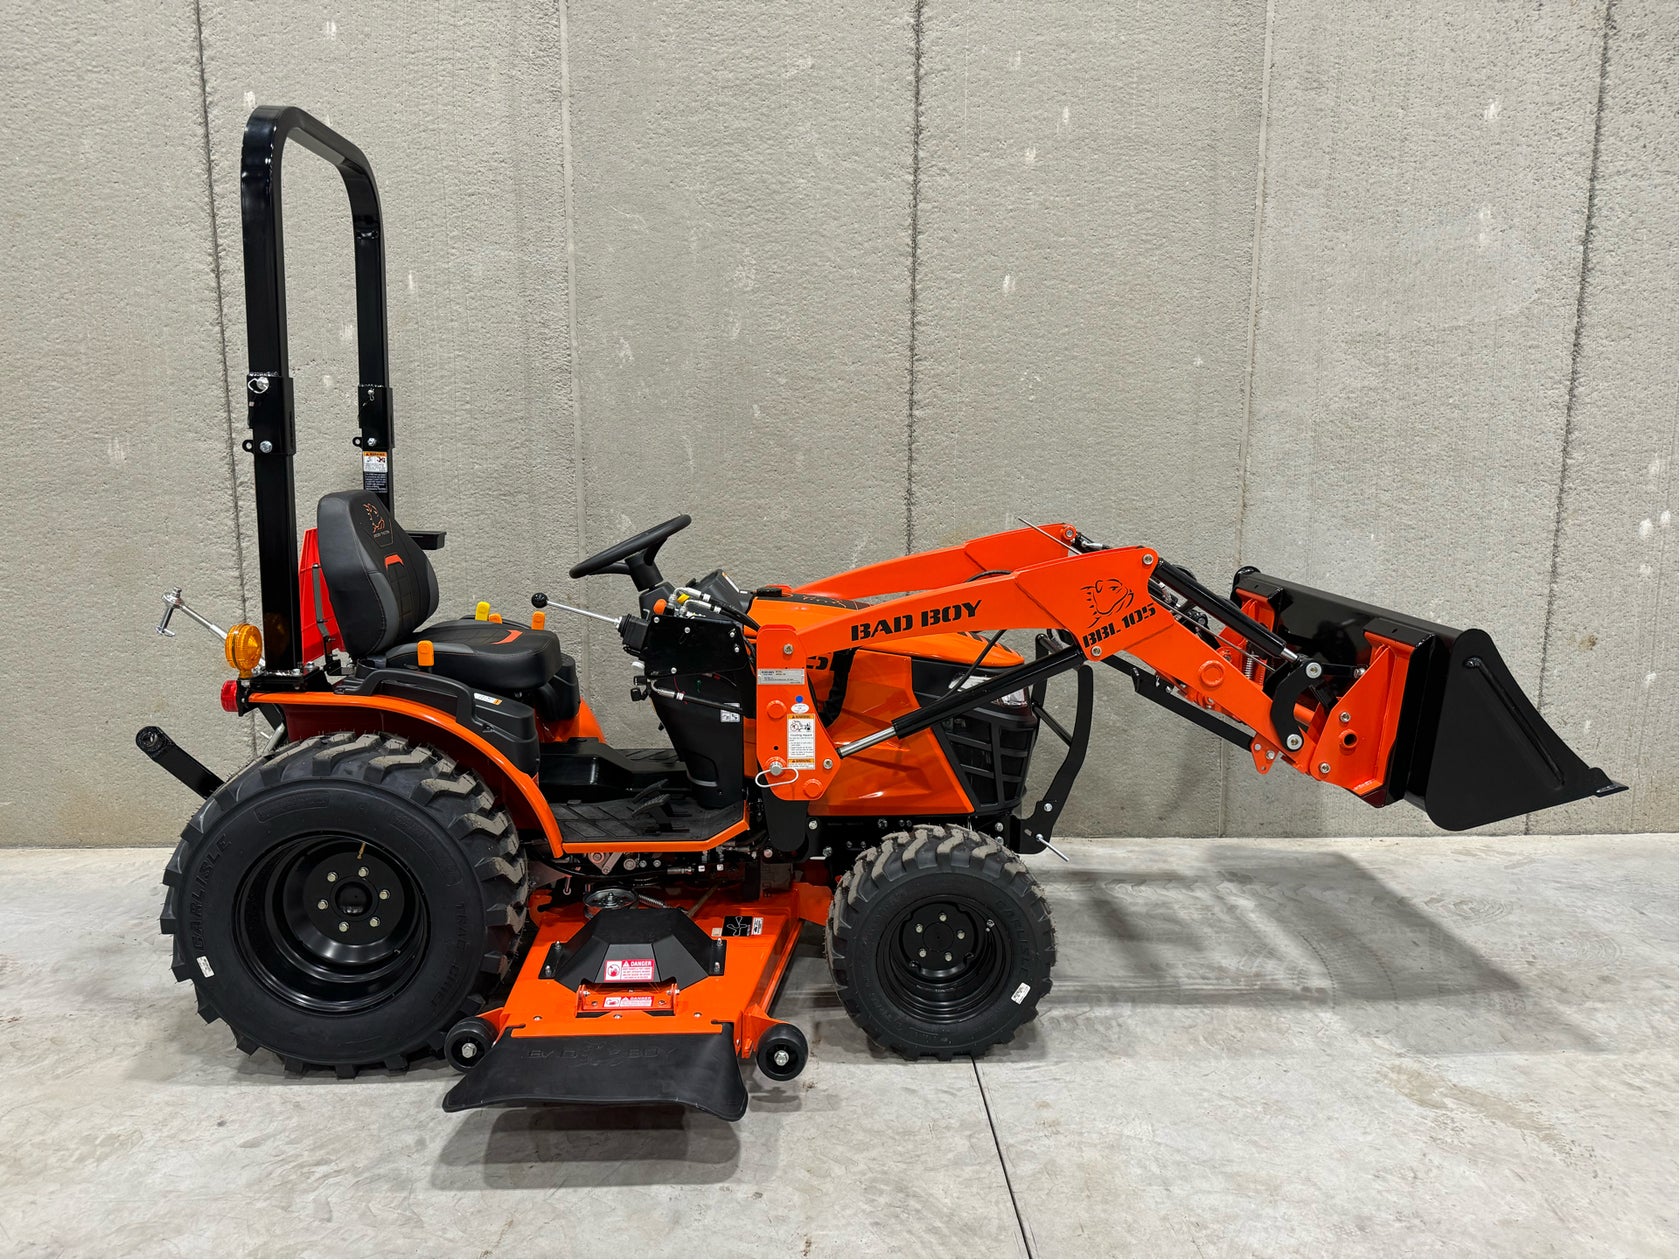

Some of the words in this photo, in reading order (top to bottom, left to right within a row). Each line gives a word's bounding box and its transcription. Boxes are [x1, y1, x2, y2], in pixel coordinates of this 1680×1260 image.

[851, 613, 914, 641] BAD
[921, 600, 983, 627] BOY
[1083, 623, 1121, 648] BBL
[1122, 603, 1156, 629] 105
